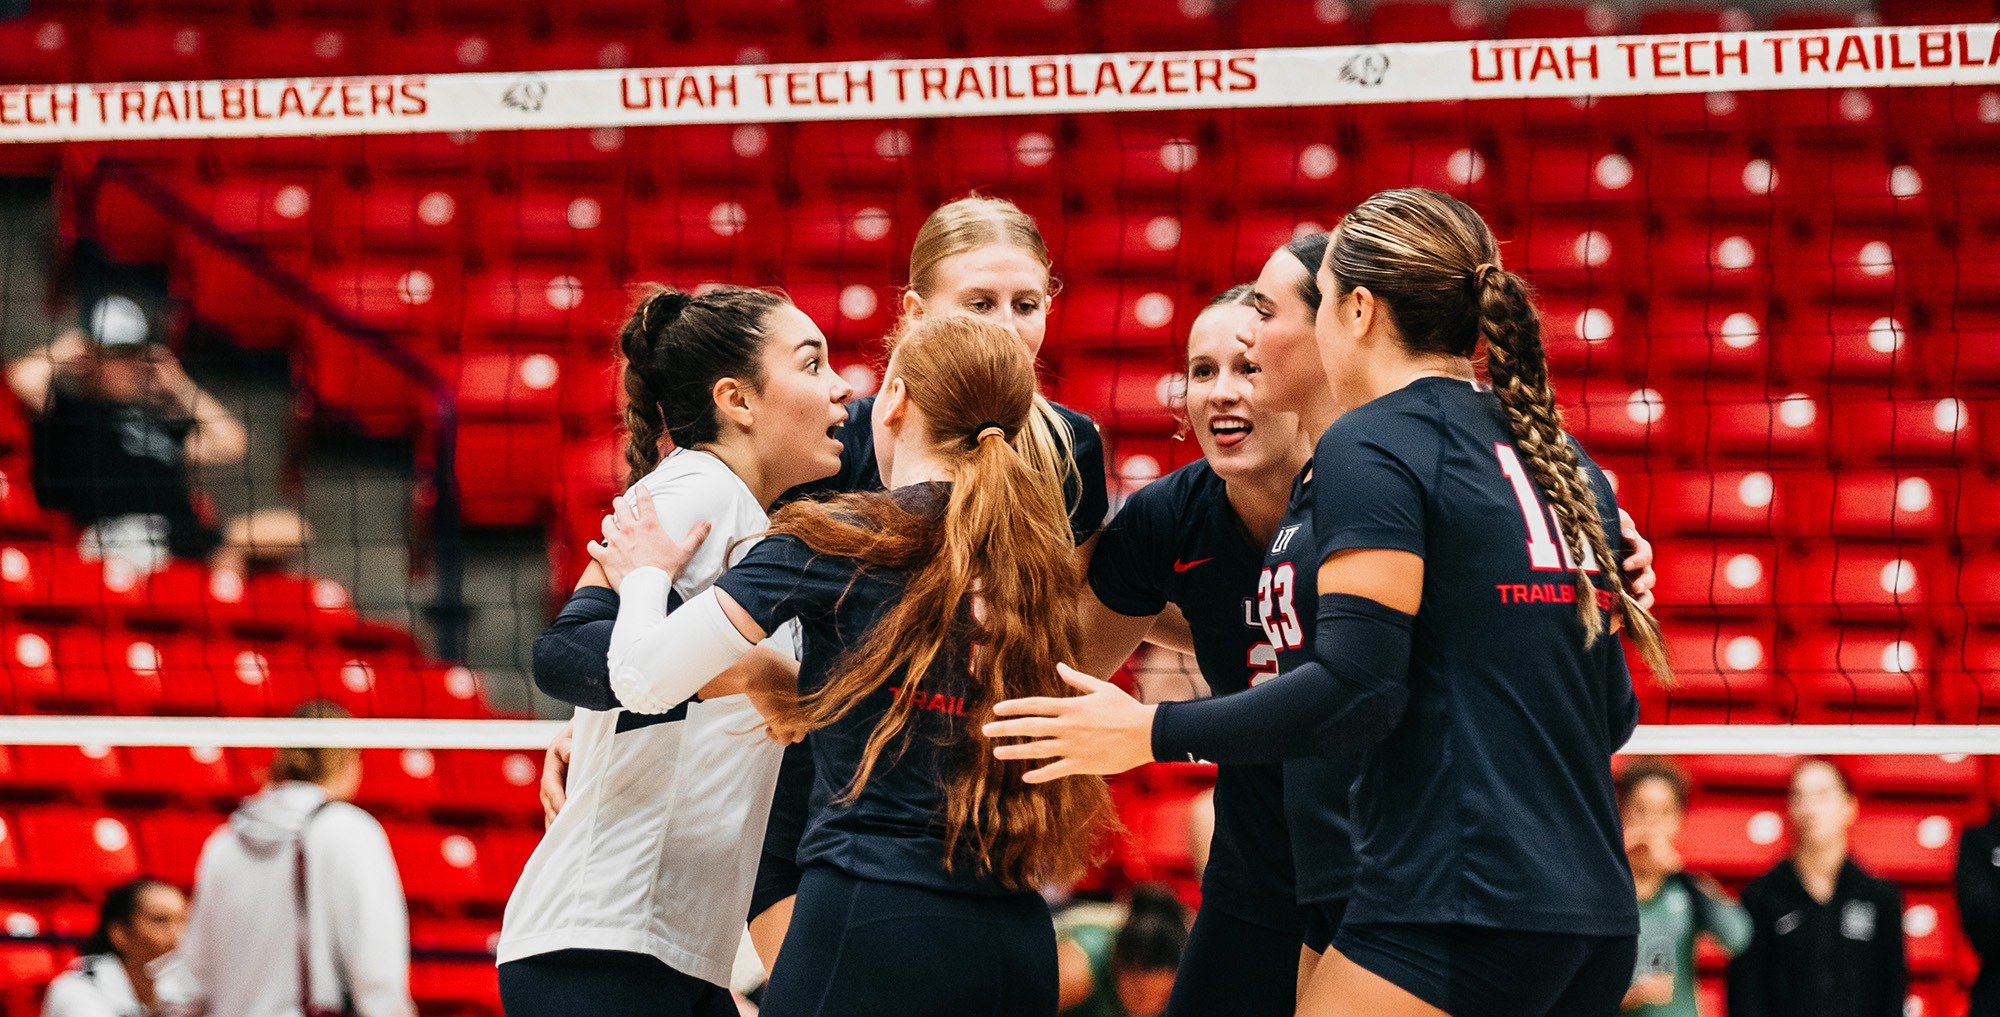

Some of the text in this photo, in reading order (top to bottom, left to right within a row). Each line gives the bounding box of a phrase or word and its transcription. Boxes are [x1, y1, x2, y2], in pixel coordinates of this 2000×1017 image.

[621, 56, 1258, 110] UTAH TECH TRAILBLAZERS
[1469, 45, 1600, 83] UTAH
[1617, 39, 1749, 79] TECH
[91, 81, 427, 123] TRAILBLAZERS
[1257, 561, 1305, 652] 23
